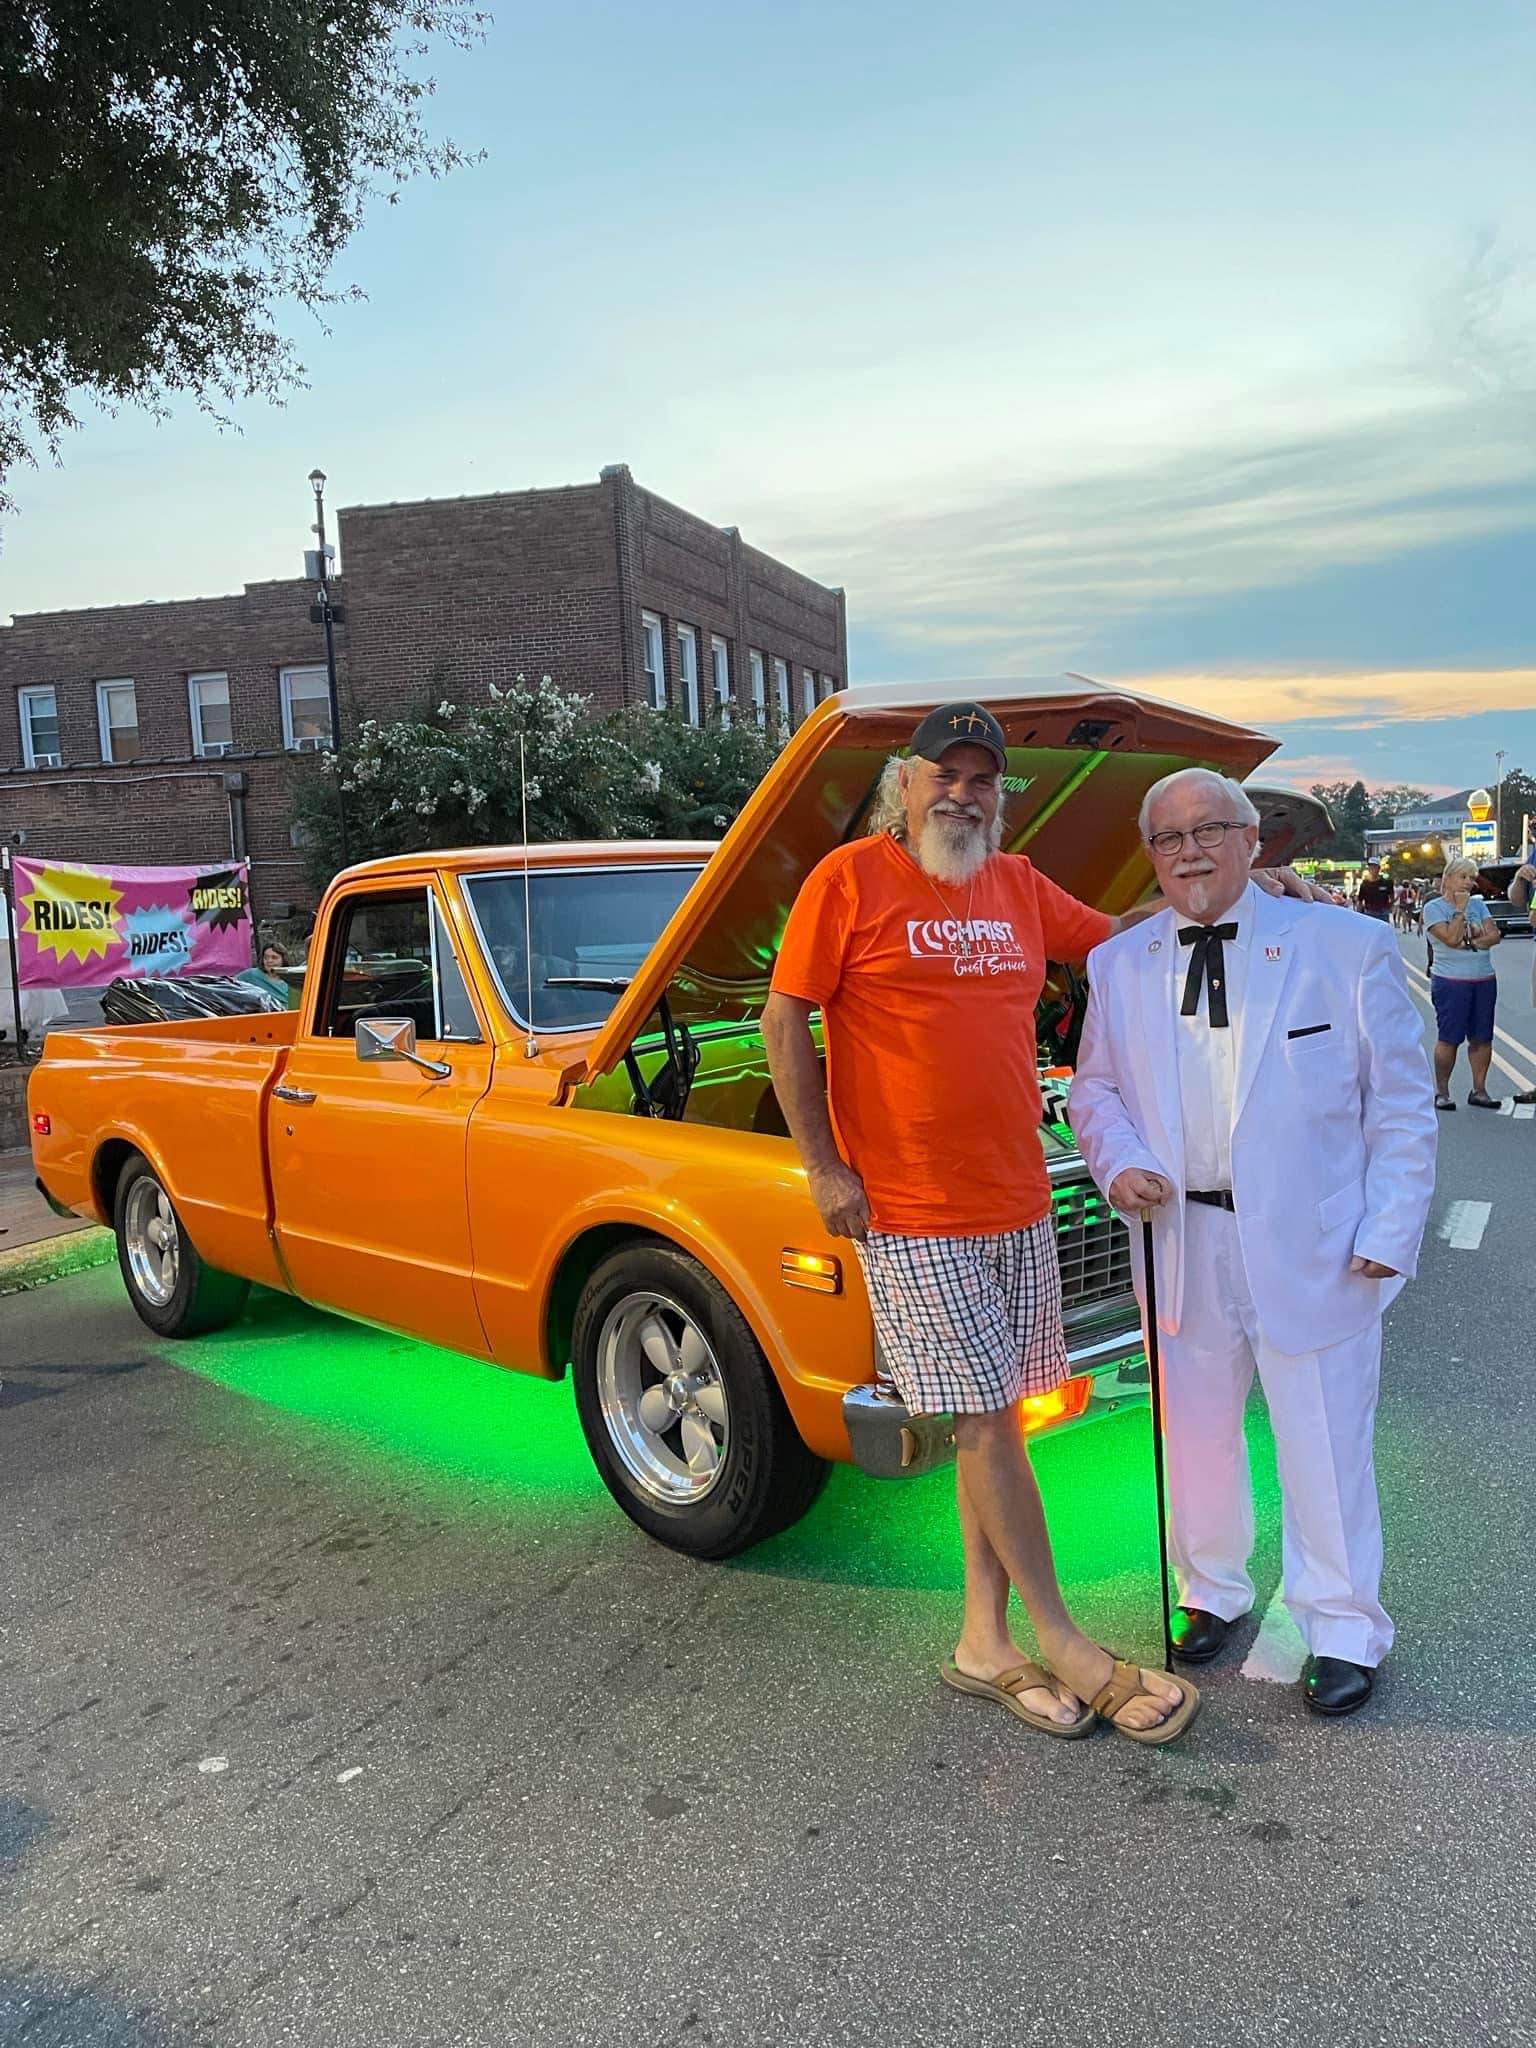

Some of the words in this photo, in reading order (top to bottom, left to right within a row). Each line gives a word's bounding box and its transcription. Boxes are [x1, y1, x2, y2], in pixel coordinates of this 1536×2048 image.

[191, 887, 242, 910] RIDES!
[33, 900, 113, 931] RIDES!
[941, 920, 1015, 942] CHRIST
[129, 931, 189, 956] RIDES!
